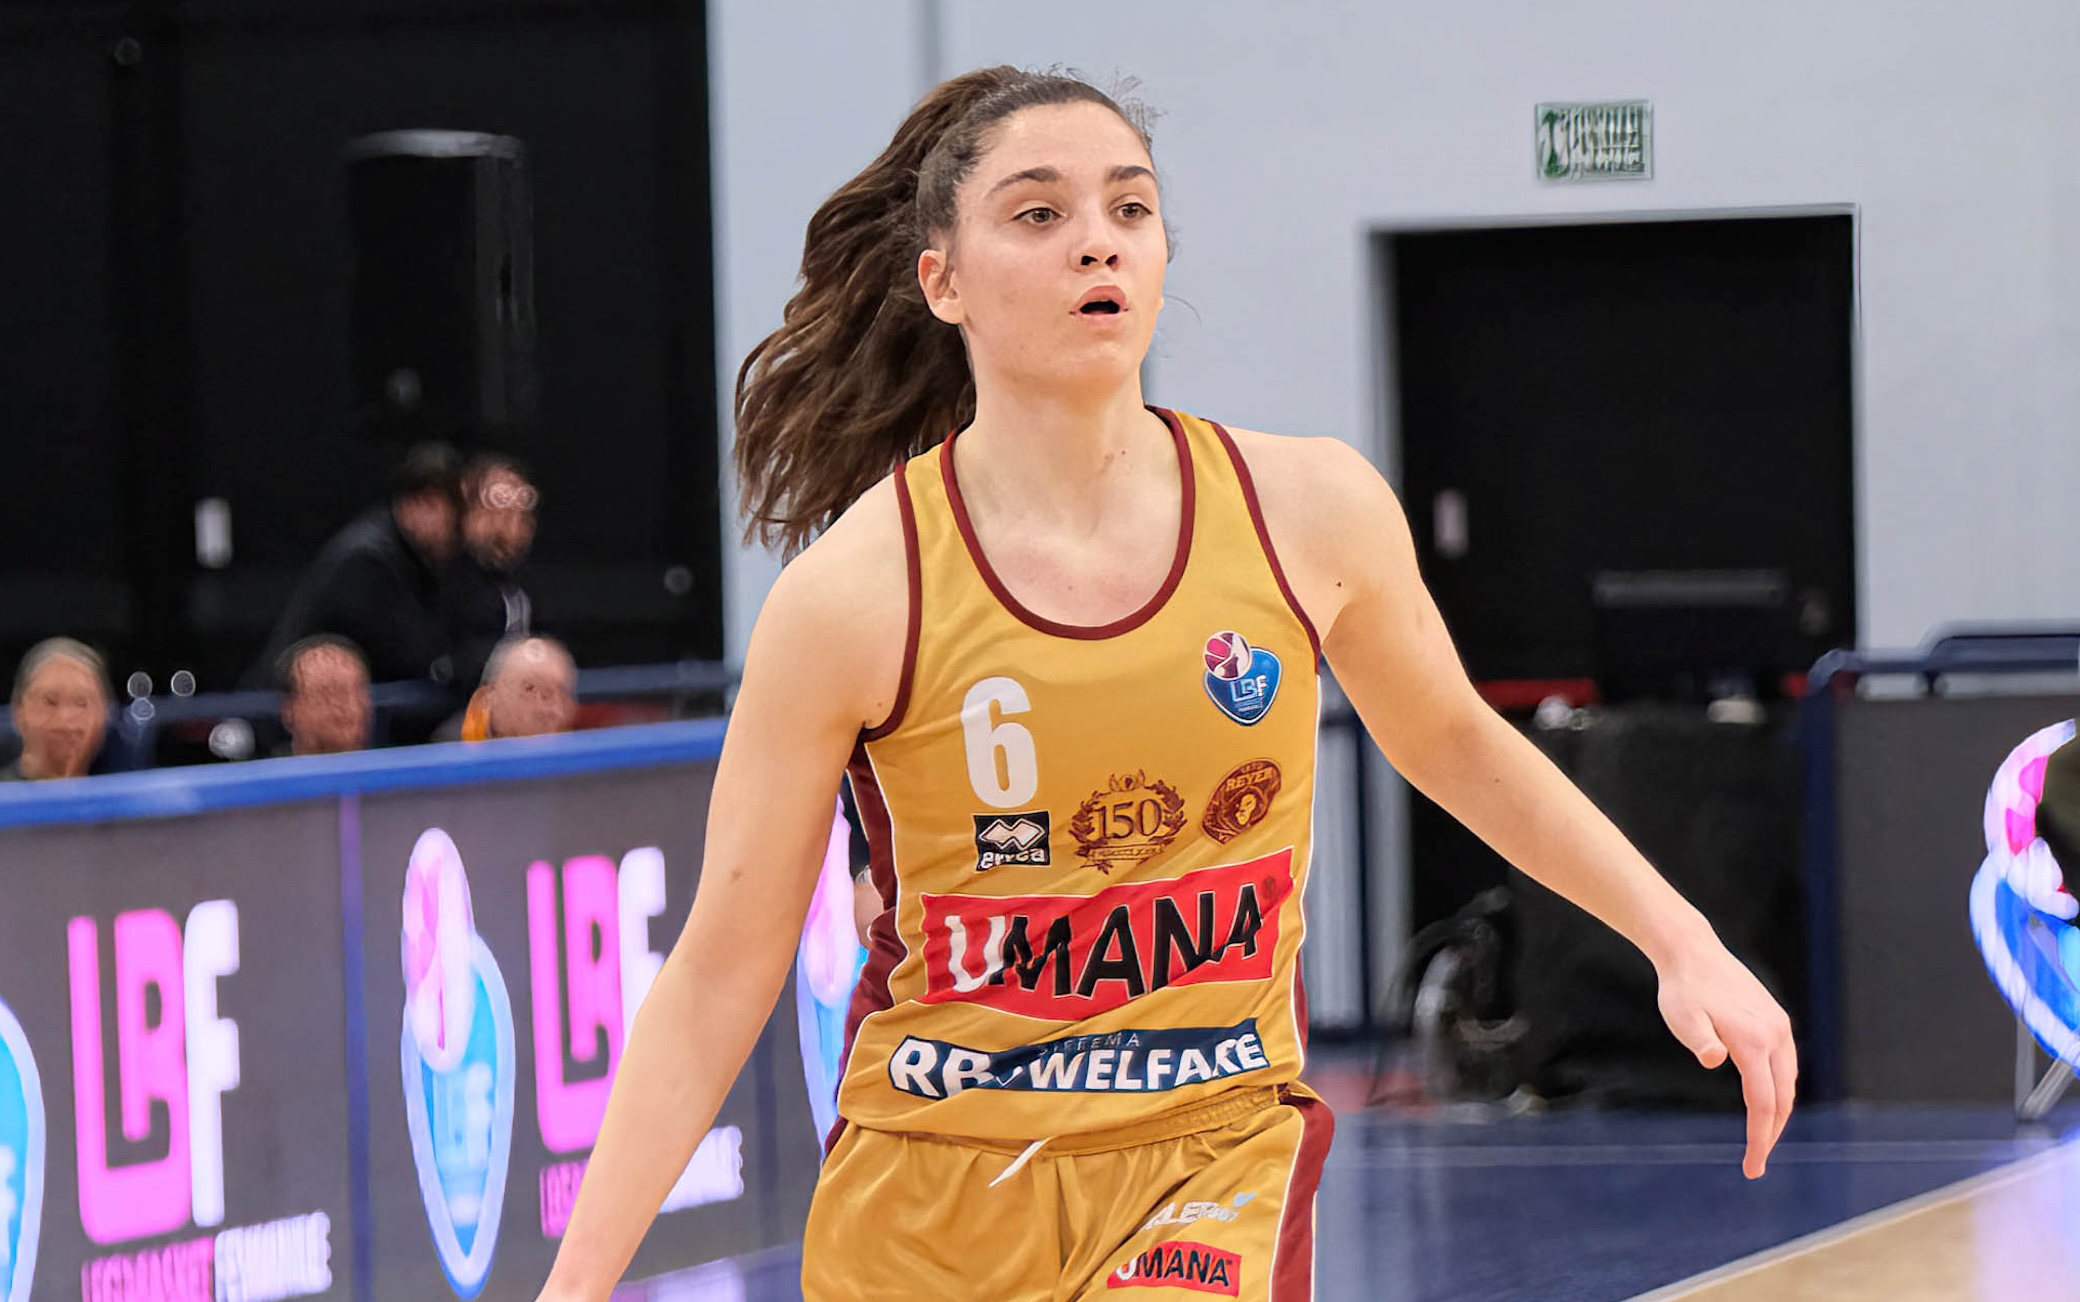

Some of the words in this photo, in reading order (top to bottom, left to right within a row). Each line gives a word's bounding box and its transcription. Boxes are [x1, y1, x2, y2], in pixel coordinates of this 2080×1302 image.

[1229, 674, 1268, 703] LBF
[960, 676, 1039, 809] 6
[1097, 798, 1163, 840] 150
[944, 883, 1263, 1001] UMANA
[67, 899, 241, 1245] LBF
[1029, 1033, 1270, 1091] WELFARE
[1115, 1246, 1230, 1288] UMANA
